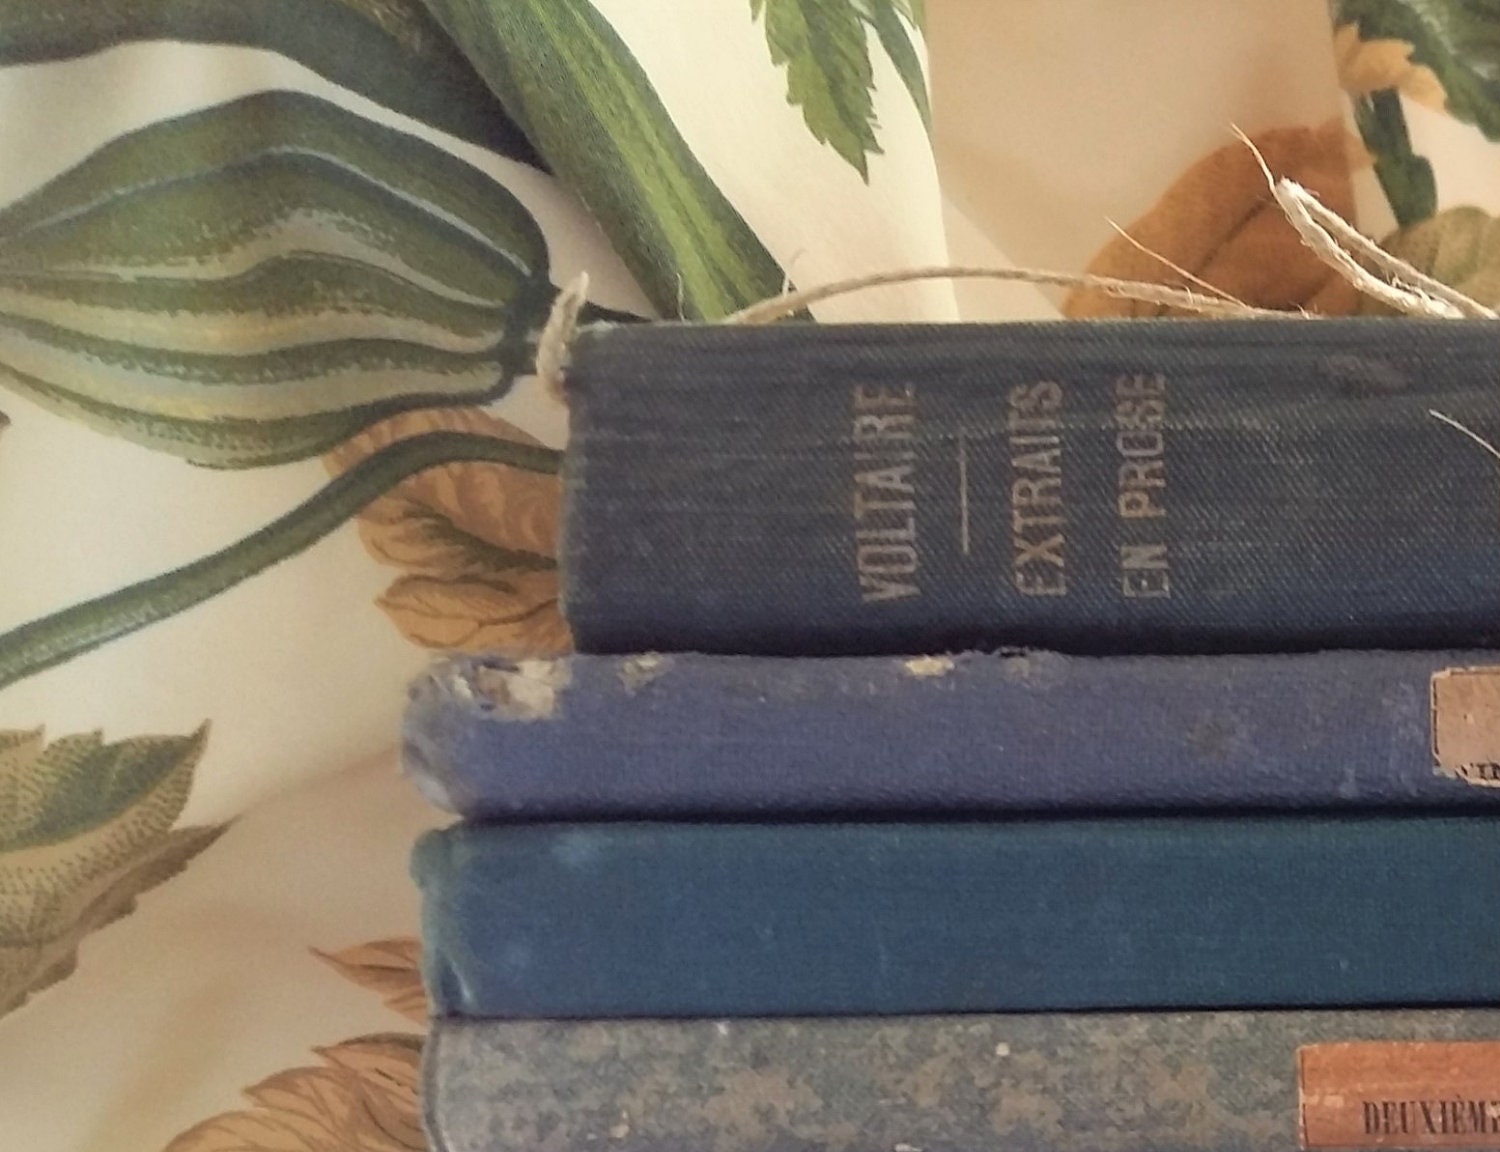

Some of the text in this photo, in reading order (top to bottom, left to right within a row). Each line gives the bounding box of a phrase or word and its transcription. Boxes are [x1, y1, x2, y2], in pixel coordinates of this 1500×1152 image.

[853, 382, 921, 601] VOLTAIRE
[1009, 380, 1067, 597] EXTRAITS
[1120, 544, 1170, 599] EN
